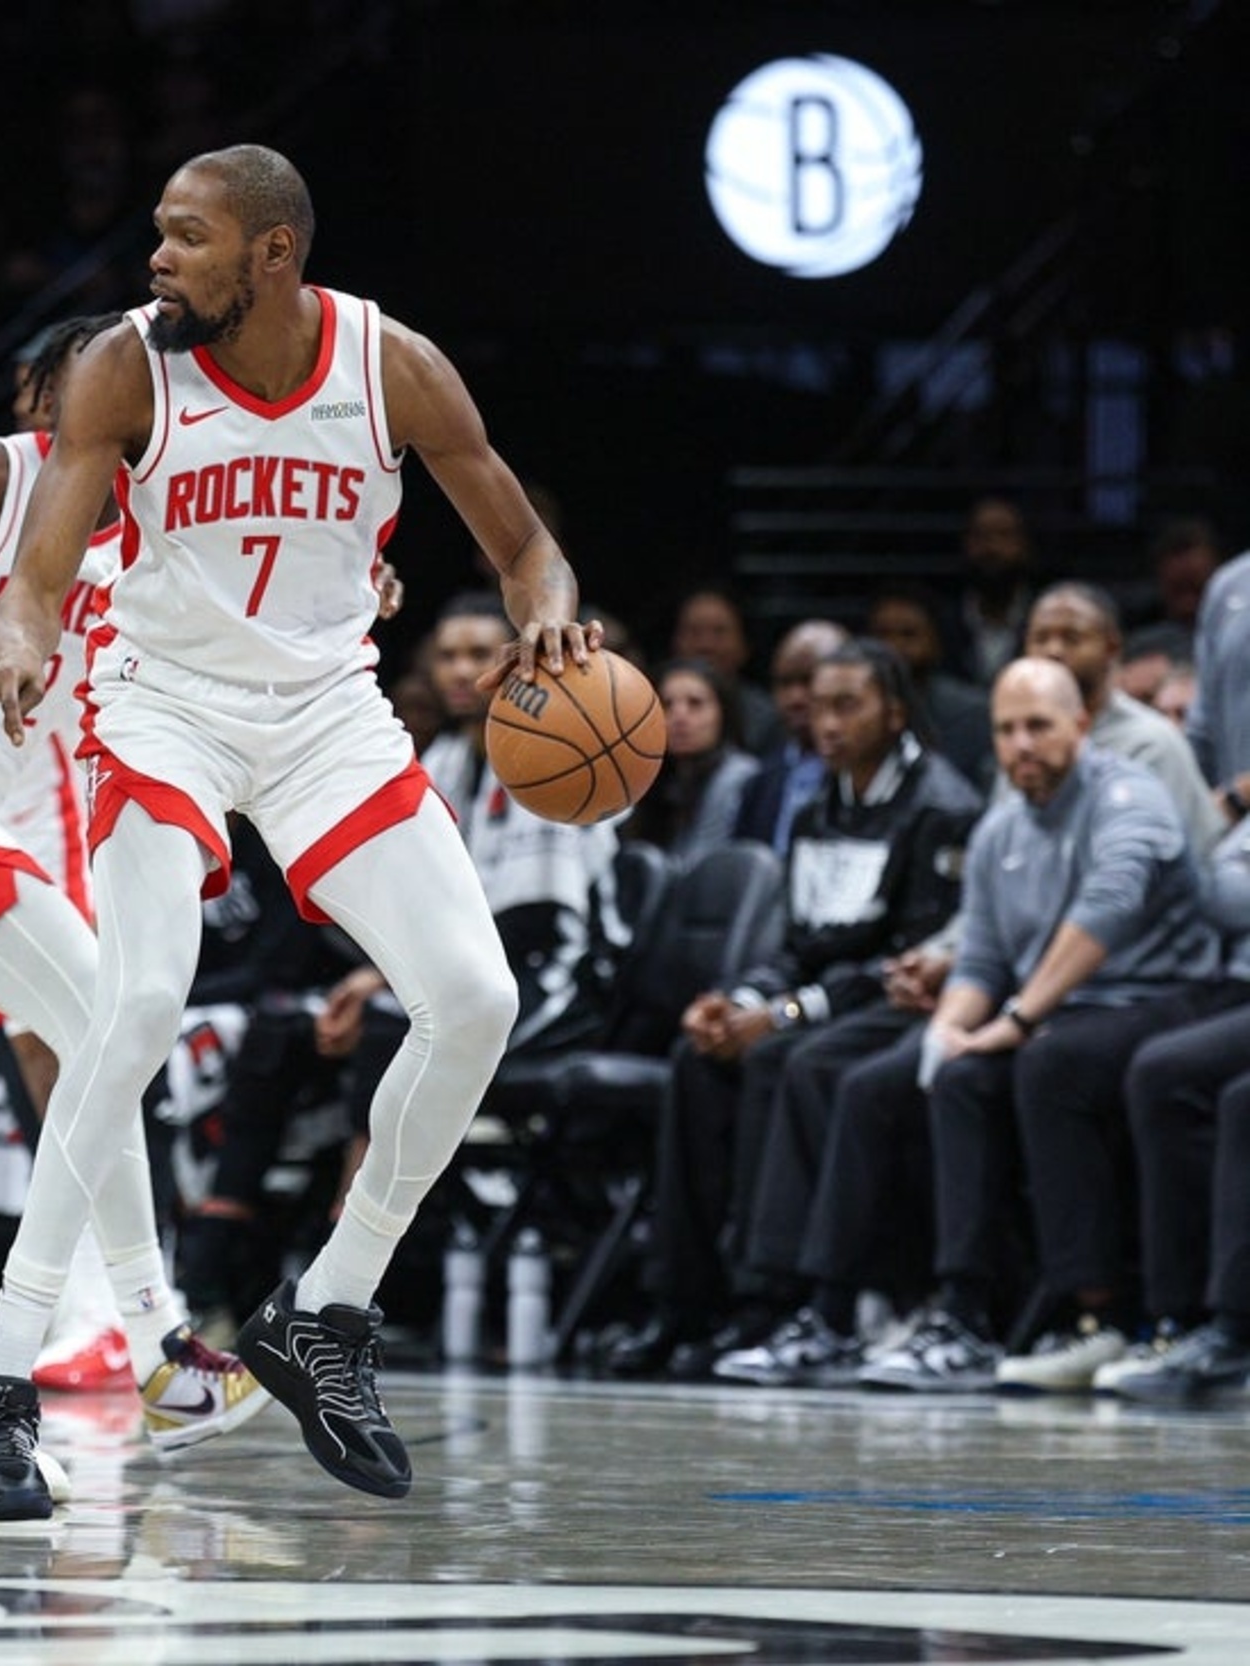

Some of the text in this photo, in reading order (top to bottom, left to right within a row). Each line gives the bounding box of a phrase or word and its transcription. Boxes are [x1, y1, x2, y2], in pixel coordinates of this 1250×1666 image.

[791, 96, 844, 236] B
[164, 456, 365, 533] ROCKETS
[241, 535, 281, 618] 7
